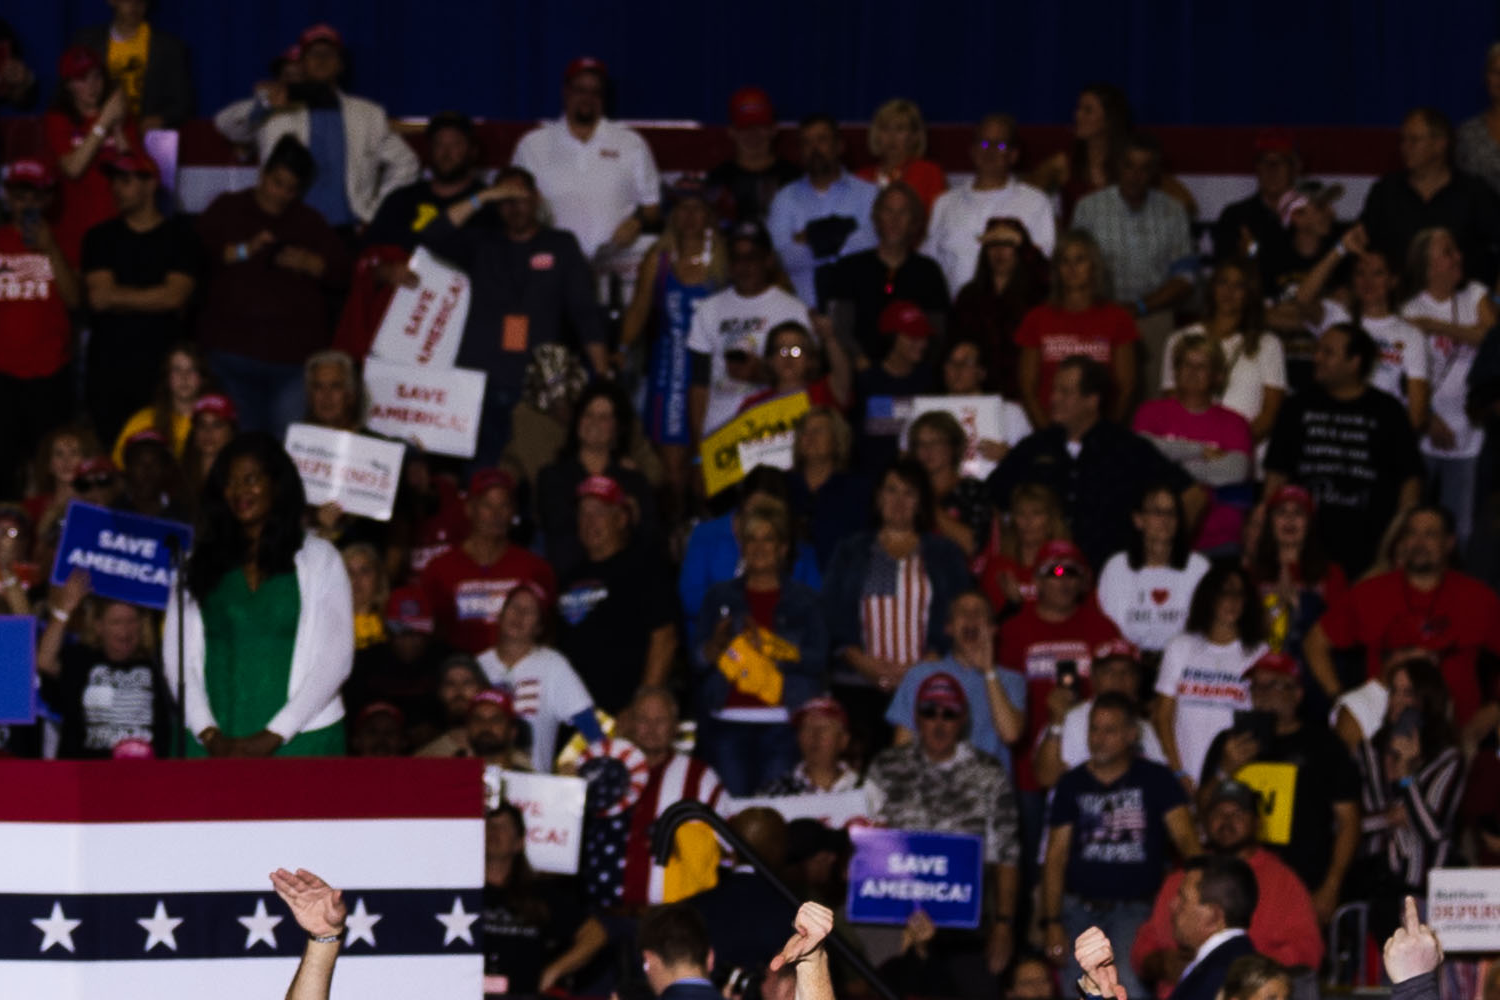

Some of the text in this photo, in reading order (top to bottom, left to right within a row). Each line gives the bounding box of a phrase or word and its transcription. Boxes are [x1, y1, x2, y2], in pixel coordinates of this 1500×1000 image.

[404, 289, 435, 336] SAVE
[396, 384, 448, 405] SAVE
[369, 404, 468, 433] AMERICA!
[98, 529, 159, 559] SAVE
[66, 547, 171, 588] AMERICA
[887, 854, 949, 877] SAVE
[860, 879, 973, 903] AMERICA!
